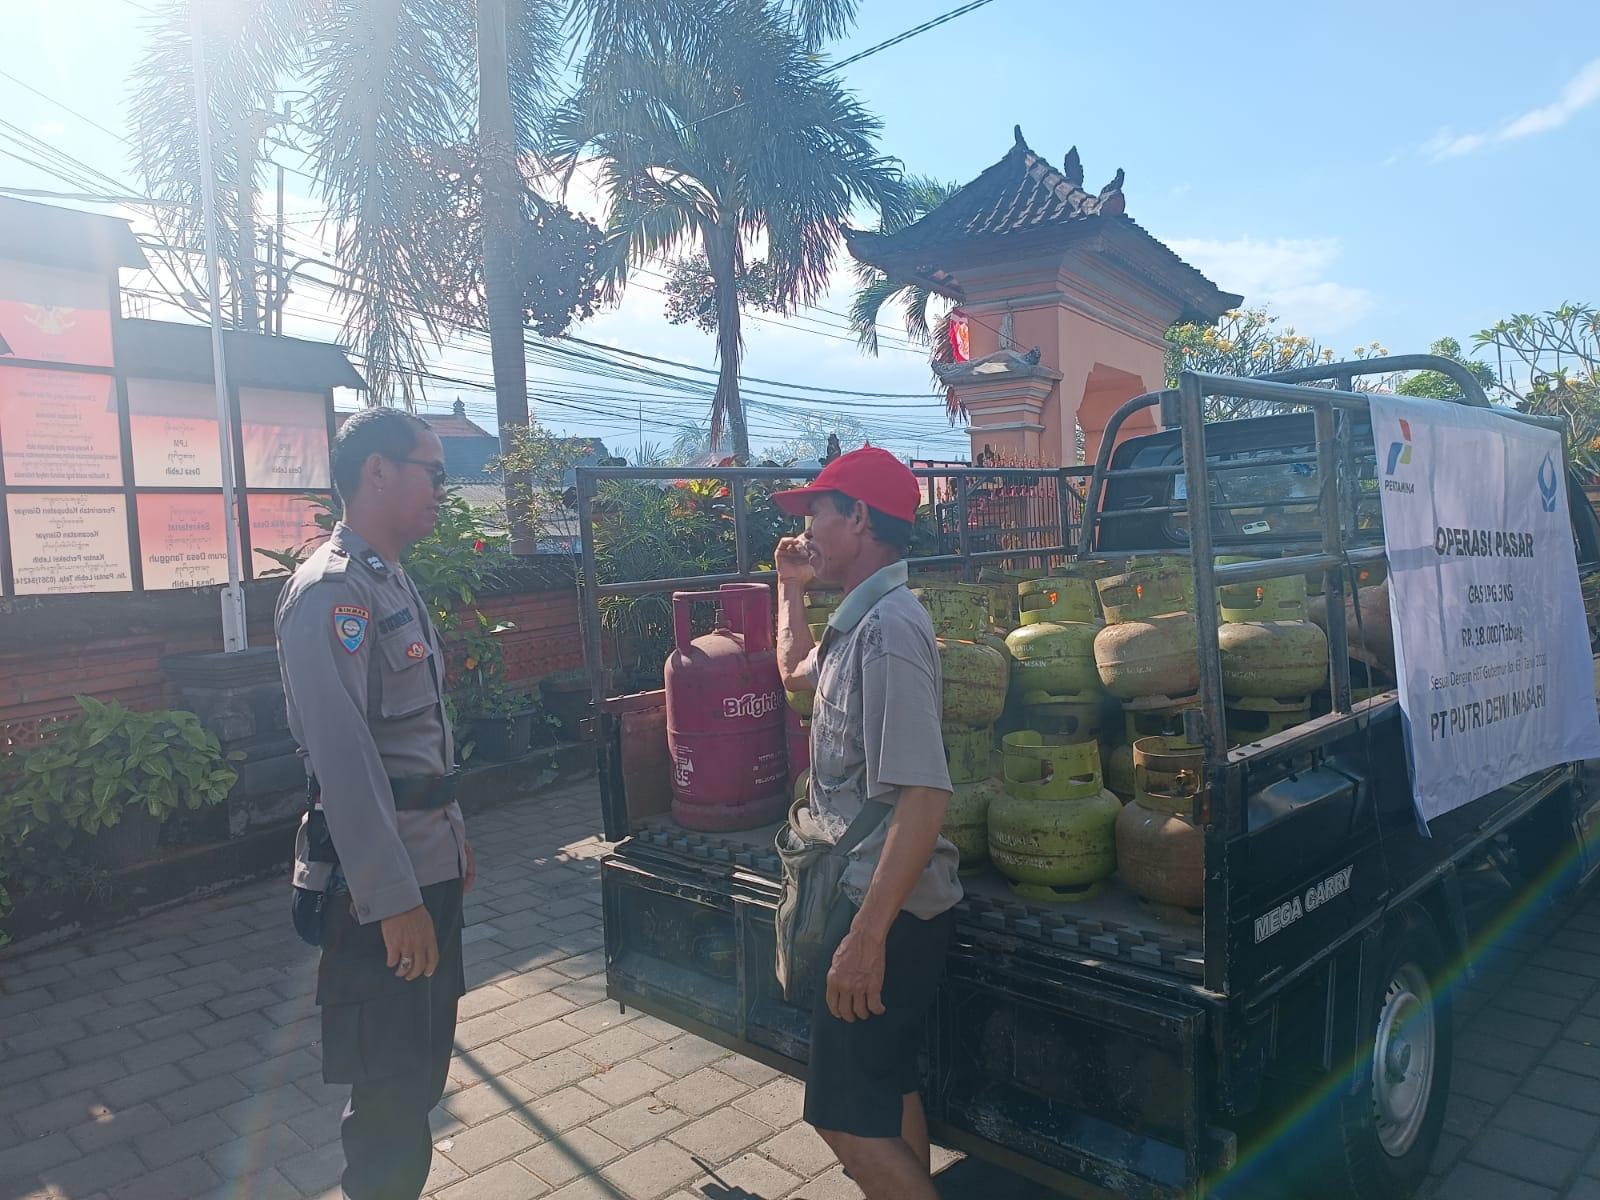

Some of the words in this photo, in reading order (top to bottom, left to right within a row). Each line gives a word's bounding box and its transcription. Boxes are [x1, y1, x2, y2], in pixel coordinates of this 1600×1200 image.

[1435, 526, 1493, 557] OPERASI
[1495, 531, 1534, 558] PASAR
[1468, 584, 1484, 604] GAS
[1503, 583, 1514, 602] KG
[723, 691, 778, 718] Bright
[1431, 711, 1448, 742] PT
[1450, 701, 1484, 736] PUTRI
[1486, 693, 1510, 725] DEWI
[1512, 683, 1546, 716] MASARI
[1254, 895, 1304, 944] MEGA
[1305, 864, 1354, 912] CARRY
